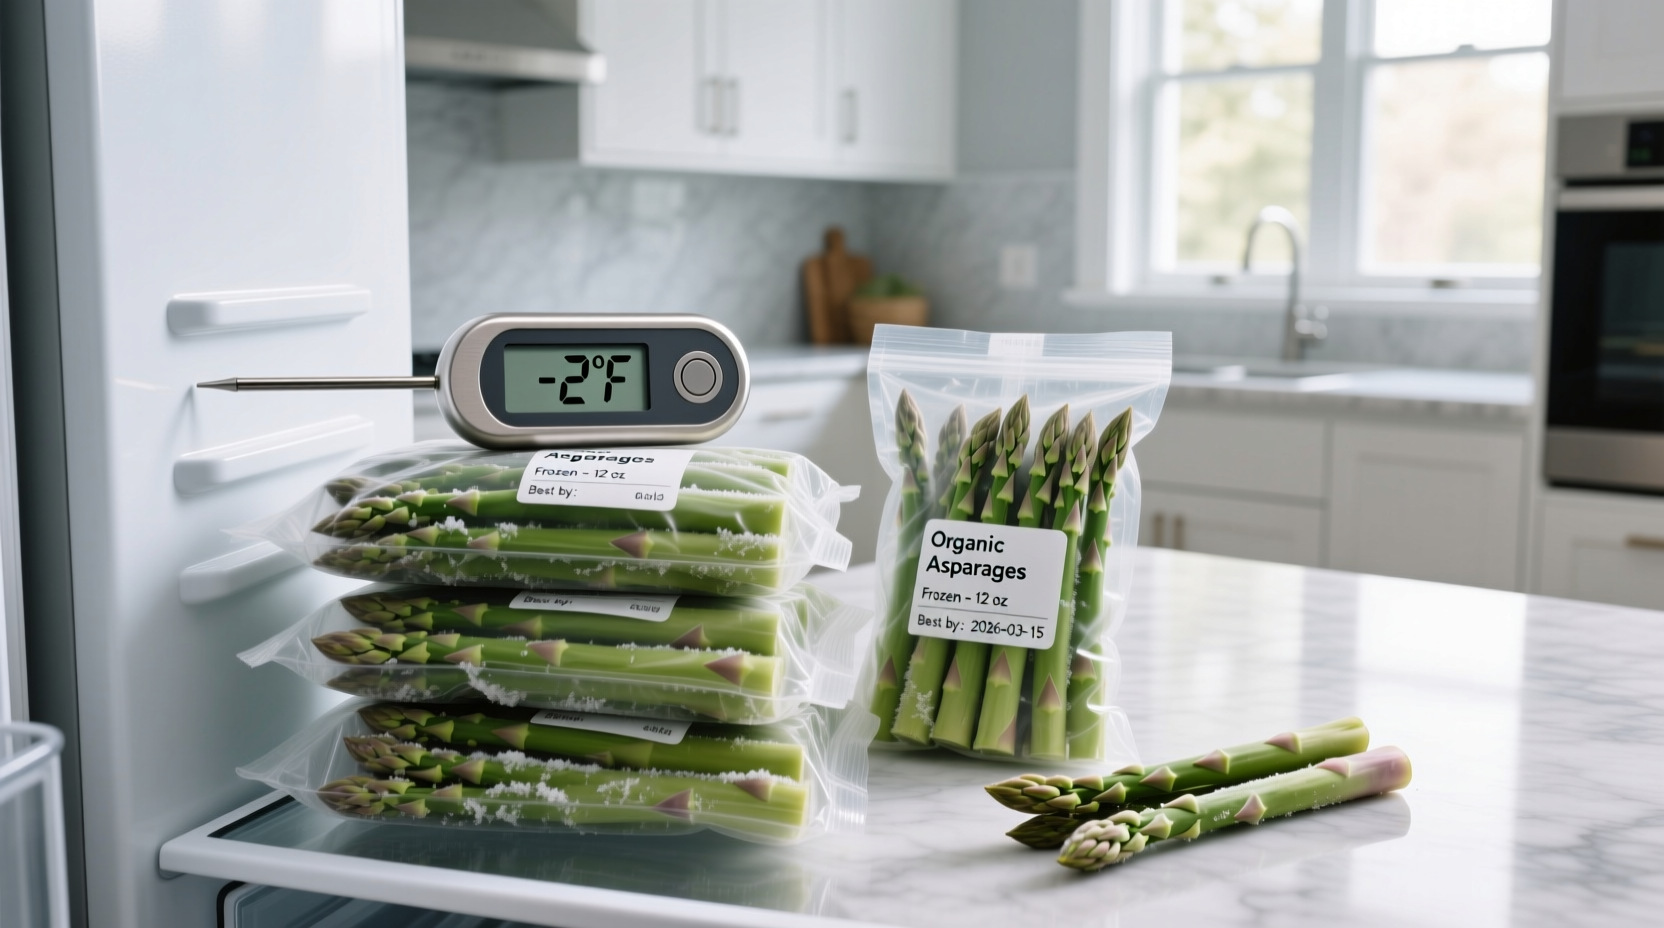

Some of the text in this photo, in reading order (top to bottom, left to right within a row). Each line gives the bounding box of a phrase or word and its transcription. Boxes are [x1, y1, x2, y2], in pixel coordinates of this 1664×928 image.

[538, 354, 632, 405] -2°F
[534, 467, 578, 477] Frozen
[594, 469, 609, 479] 12
[610, 471, 626, 480] oz
[528, 484, 578, 499] Best by:
[931, 530, 1005, 555] Organic
[926, 555, 1027, 583] Asparages
[921, 586, 961, 603] Frozen
[975, 591, 990, 605] 12
[992, 595, 1009, 607] oz
[917, 613, 1045, 639] Best by: 2026-03-15
